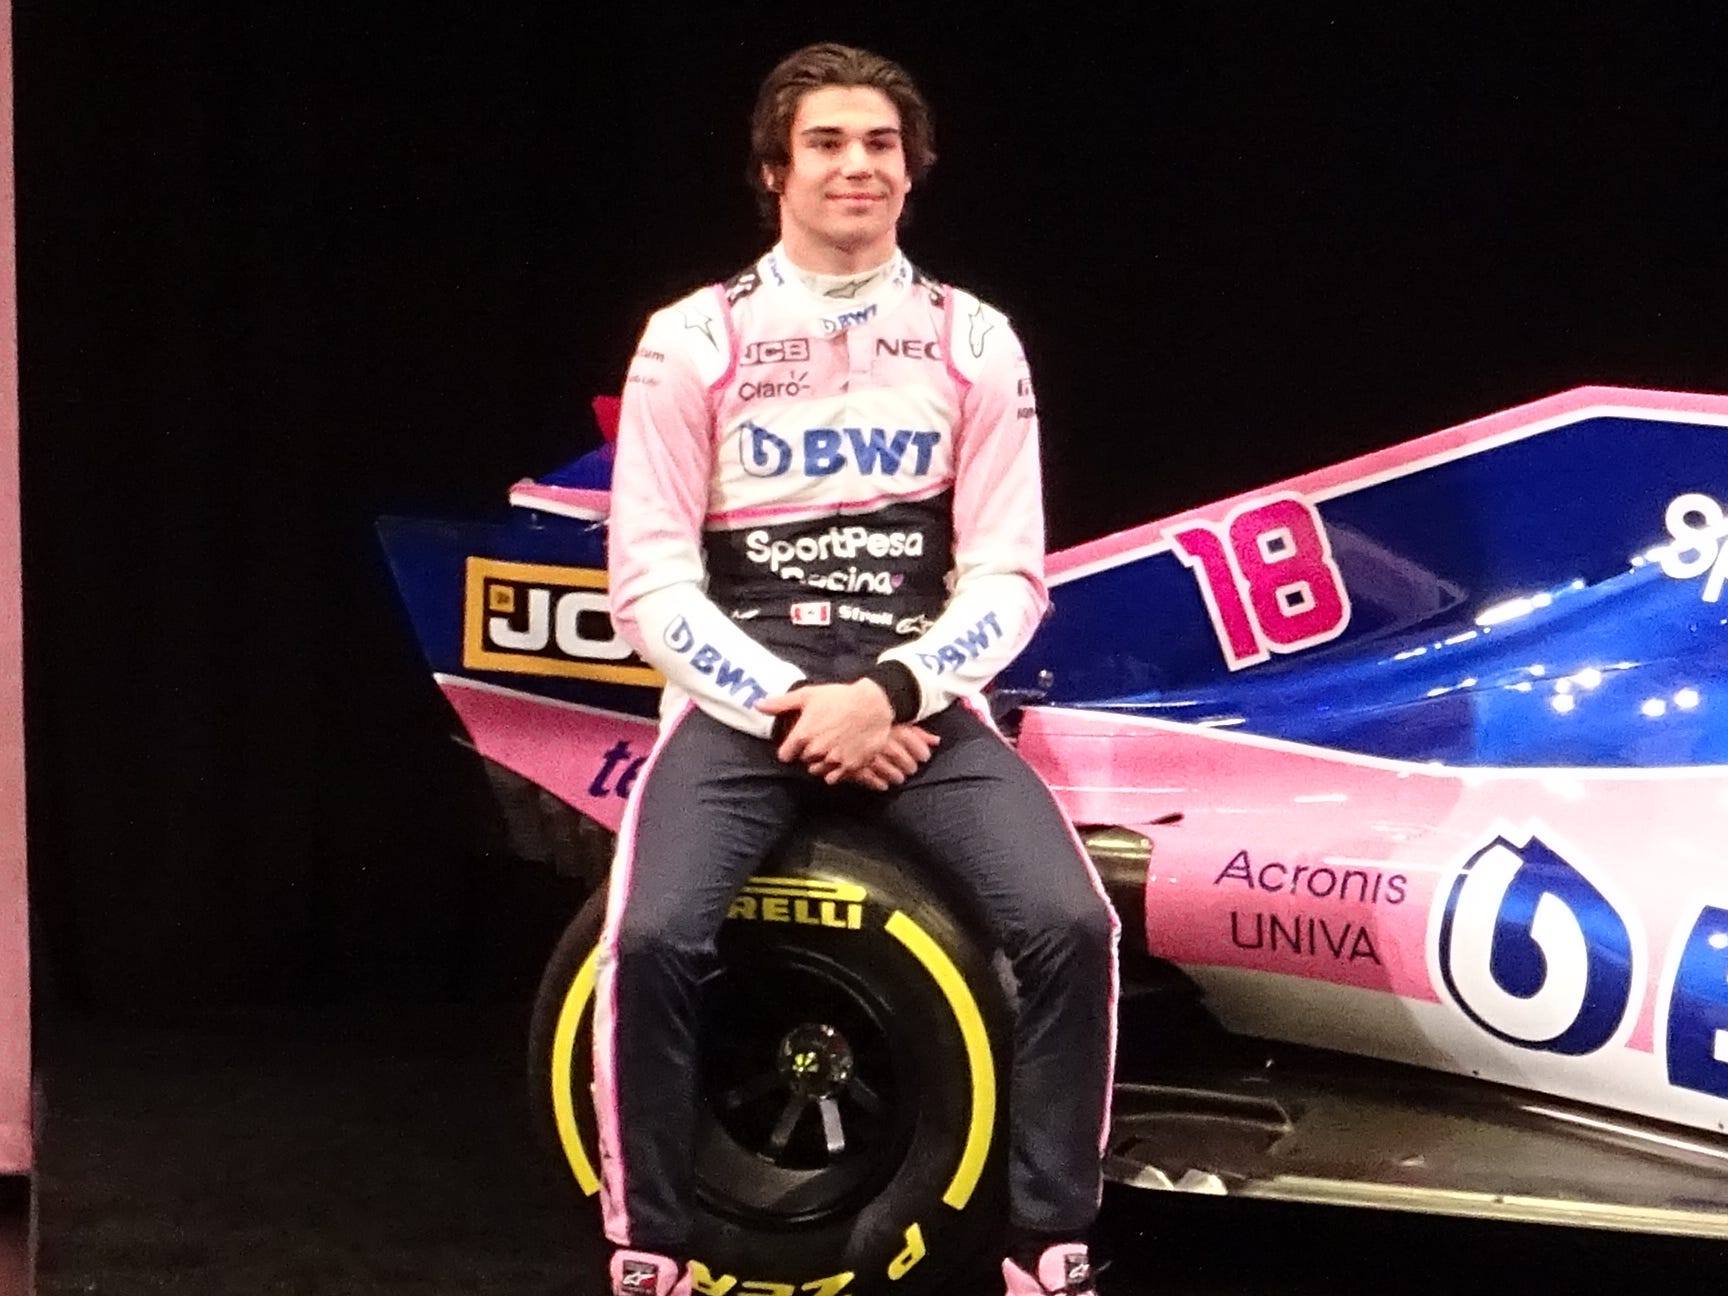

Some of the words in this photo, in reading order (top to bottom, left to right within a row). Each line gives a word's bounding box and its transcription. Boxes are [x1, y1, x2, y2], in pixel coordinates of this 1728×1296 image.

[740, 337, 811, 366] JCB
[738, 380, 801, 402] Claro
[803, 427, 941, 477] BWT
[746, 526, 923, 573] SportPesa
[1166, 493, 1350, 670] 18
[487, 587, 636, 661] JC
[937, 610, 1006, 675] BWT
[689, 642, 769, 711] BWT
[727, 877, 867, 931] RELLI
[1213, 849, 1409, 906] Acronis
[1230, 912, 1382, 966] UNIVA
